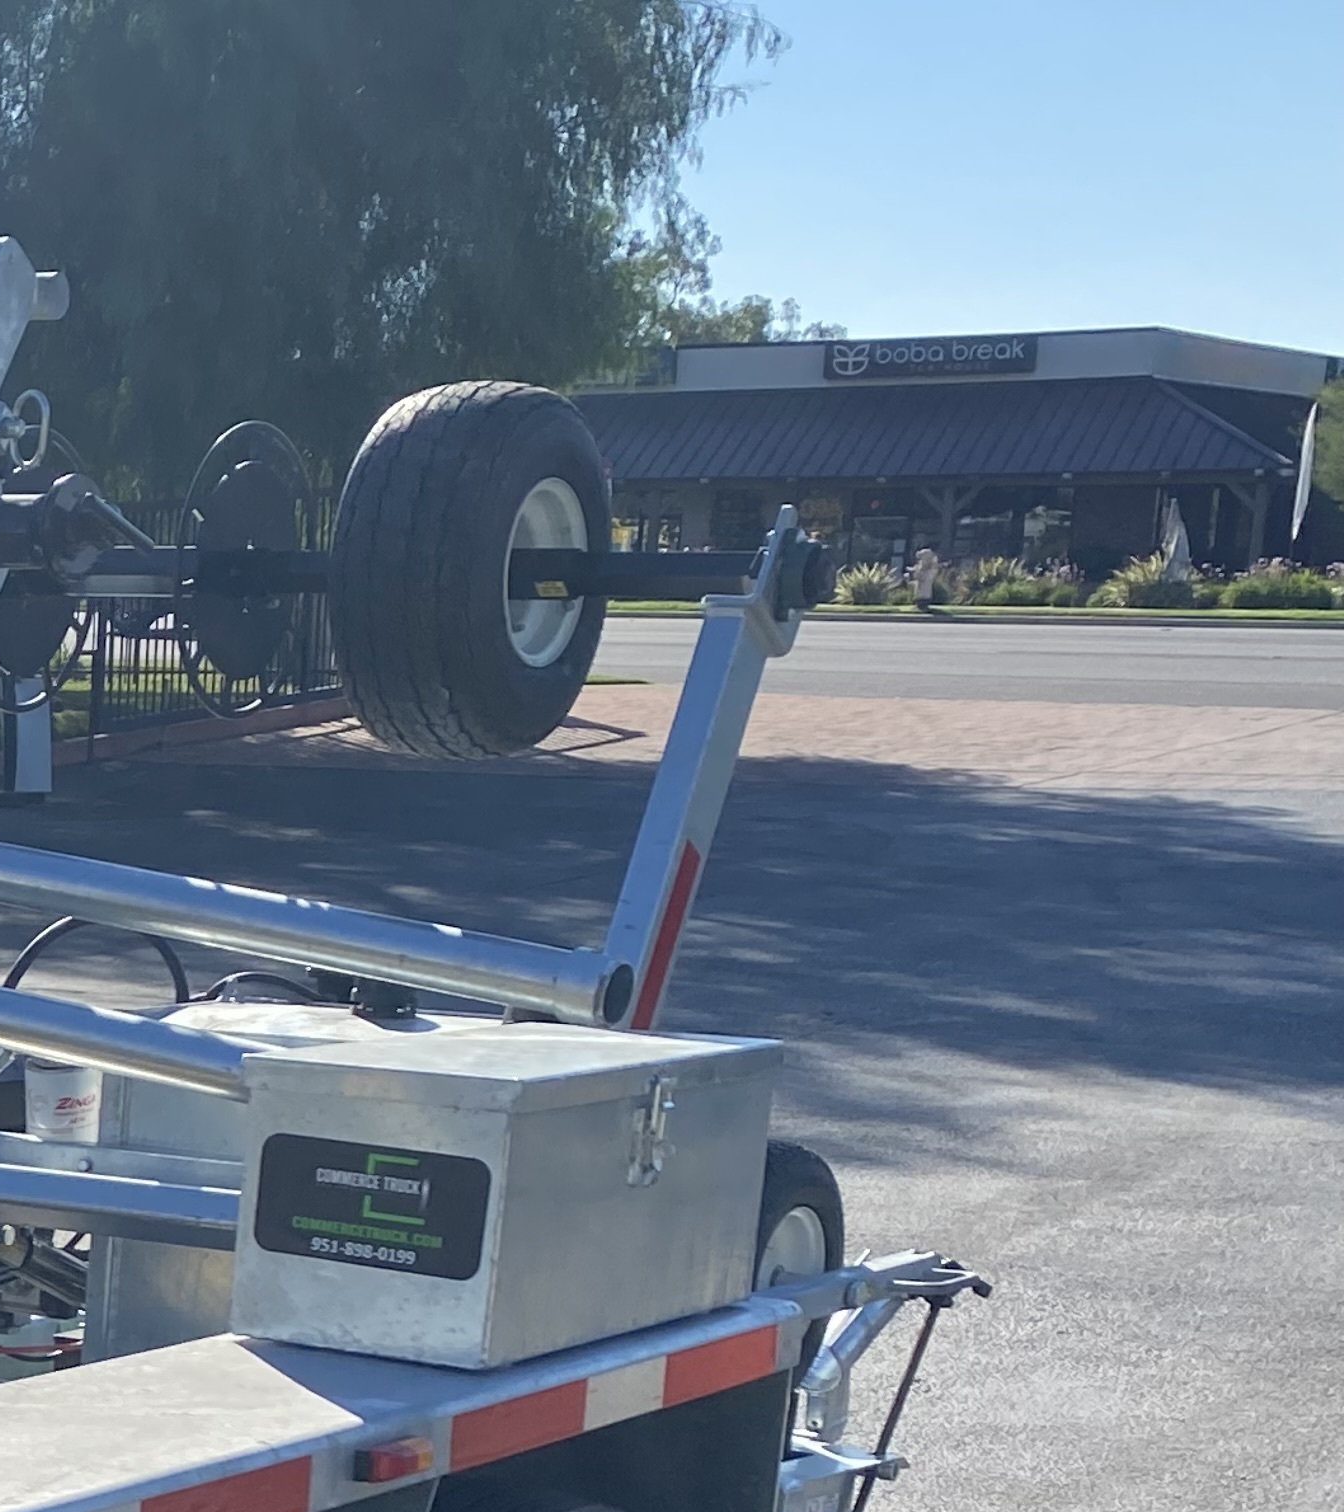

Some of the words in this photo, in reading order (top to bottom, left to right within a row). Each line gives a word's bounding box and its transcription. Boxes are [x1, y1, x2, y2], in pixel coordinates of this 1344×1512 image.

[875, 342, 945, 366] boba
[952, 337, 1026, 363] break
[315, 1166, 380, 1190] COMMERCE
[383, 1174, 422, 1195] TRUCK
[309, 1236, 416, 1266] 951-898-0199
